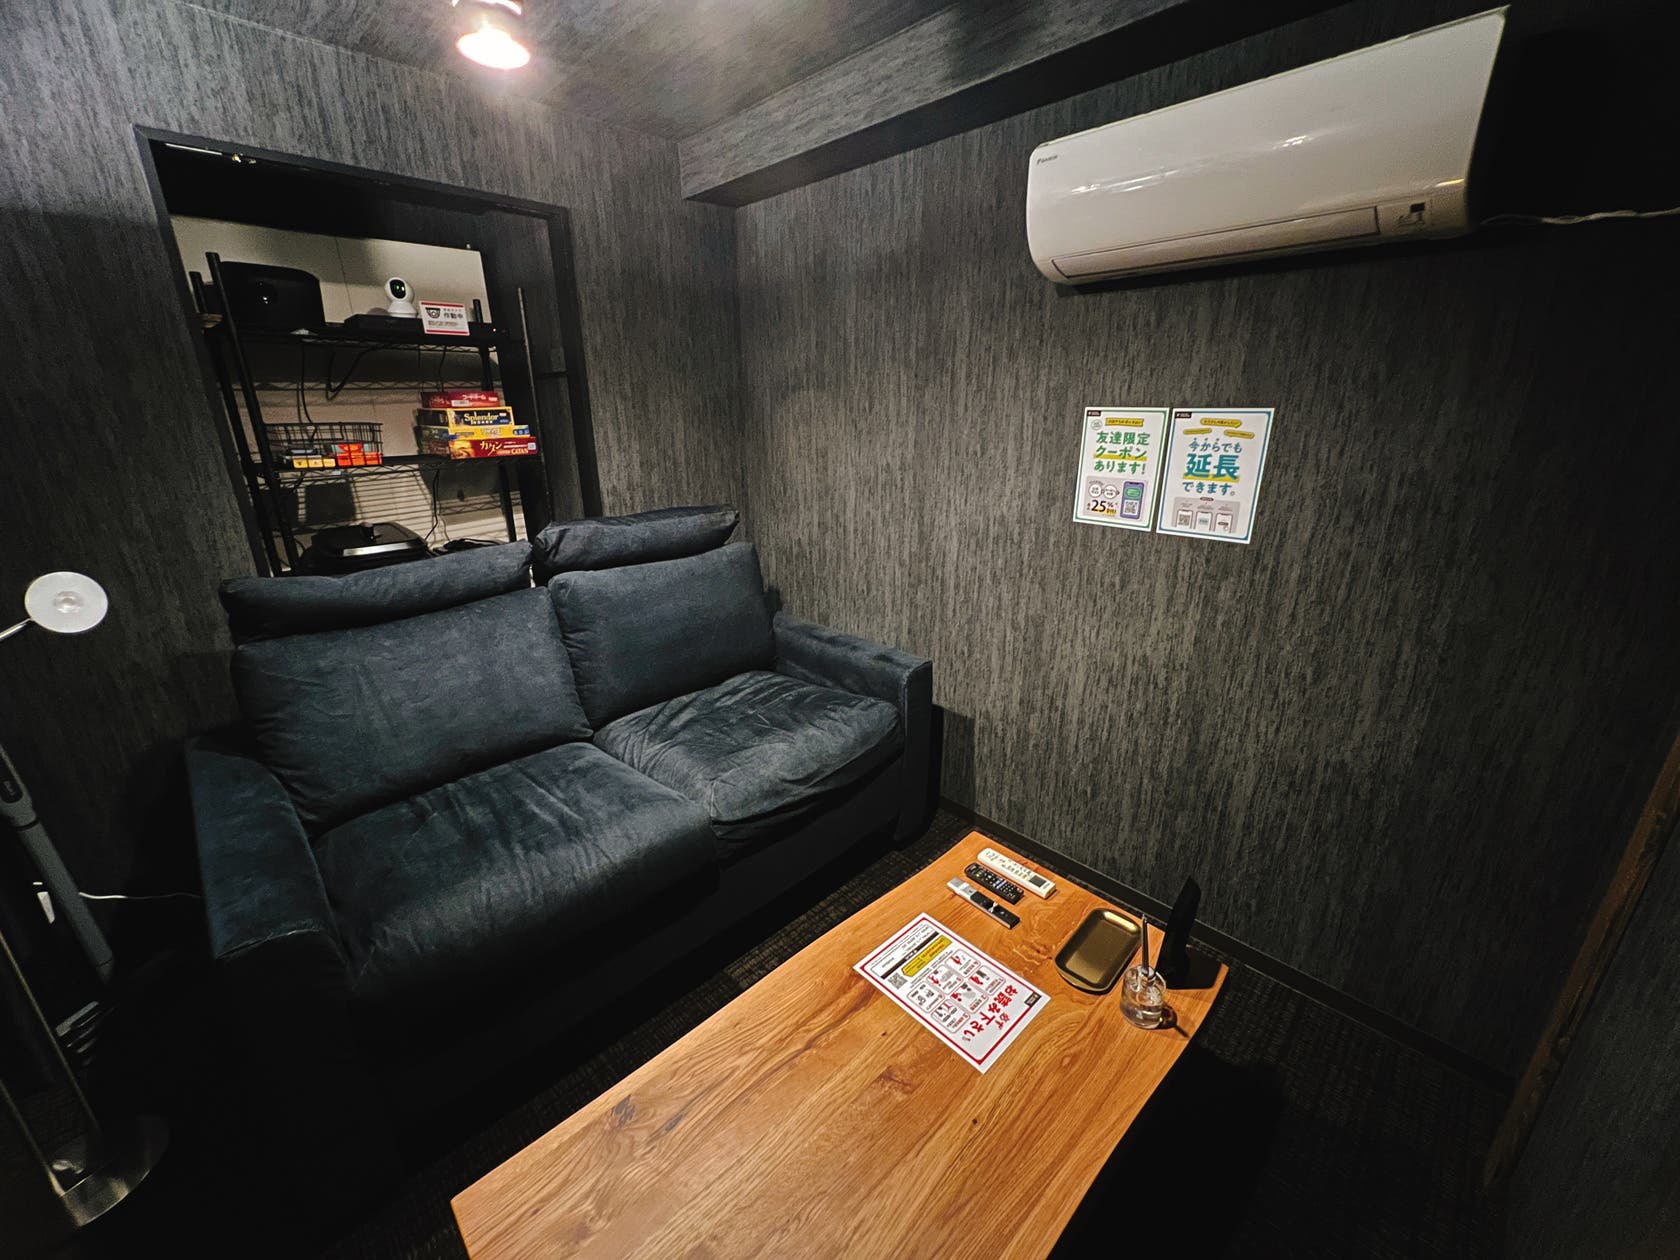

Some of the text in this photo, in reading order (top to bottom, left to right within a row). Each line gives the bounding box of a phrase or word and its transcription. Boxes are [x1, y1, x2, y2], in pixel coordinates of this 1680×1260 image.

[464, 411, 499, 425] Splendor
[1096, 431, 1151, 446] 友達限定
[480, 441, 502, 456] カタン
[1095, 446, 1147, 460] クーポン
[1188, 441, 1242, 453] 今からでも
[1093, 461, 1146, 475] あります!
[1184, 453, 1240, 480] 延長
[1182, 481, 1236, 496] できます。
[961, 985, 1018, 1042] お読み下さい
[995, 1012, 1010, 1030] 必ず
